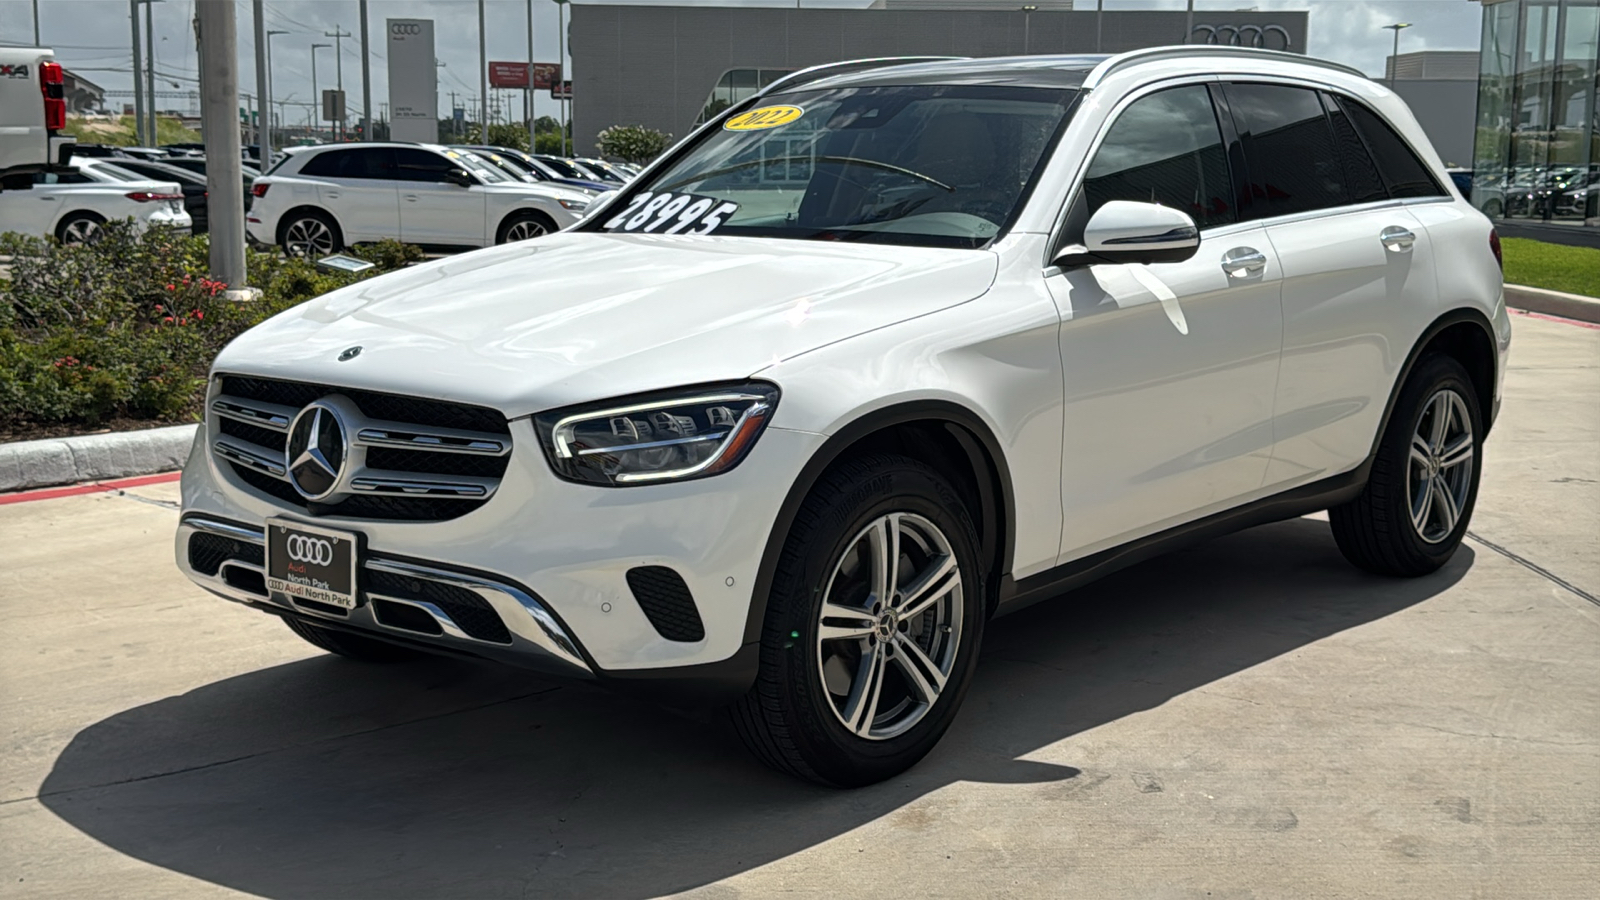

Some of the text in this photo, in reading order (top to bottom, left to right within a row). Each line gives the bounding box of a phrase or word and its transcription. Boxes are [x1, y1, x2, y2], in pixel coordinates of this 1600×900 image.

[732, 109, 795, 127] 2022
[604, 192, 738, 235] 28995
[288, 562, 306, 573] Audi
[287, 573, 329, 590] North Park
[285, 584, 351, 606] Audi North Park
